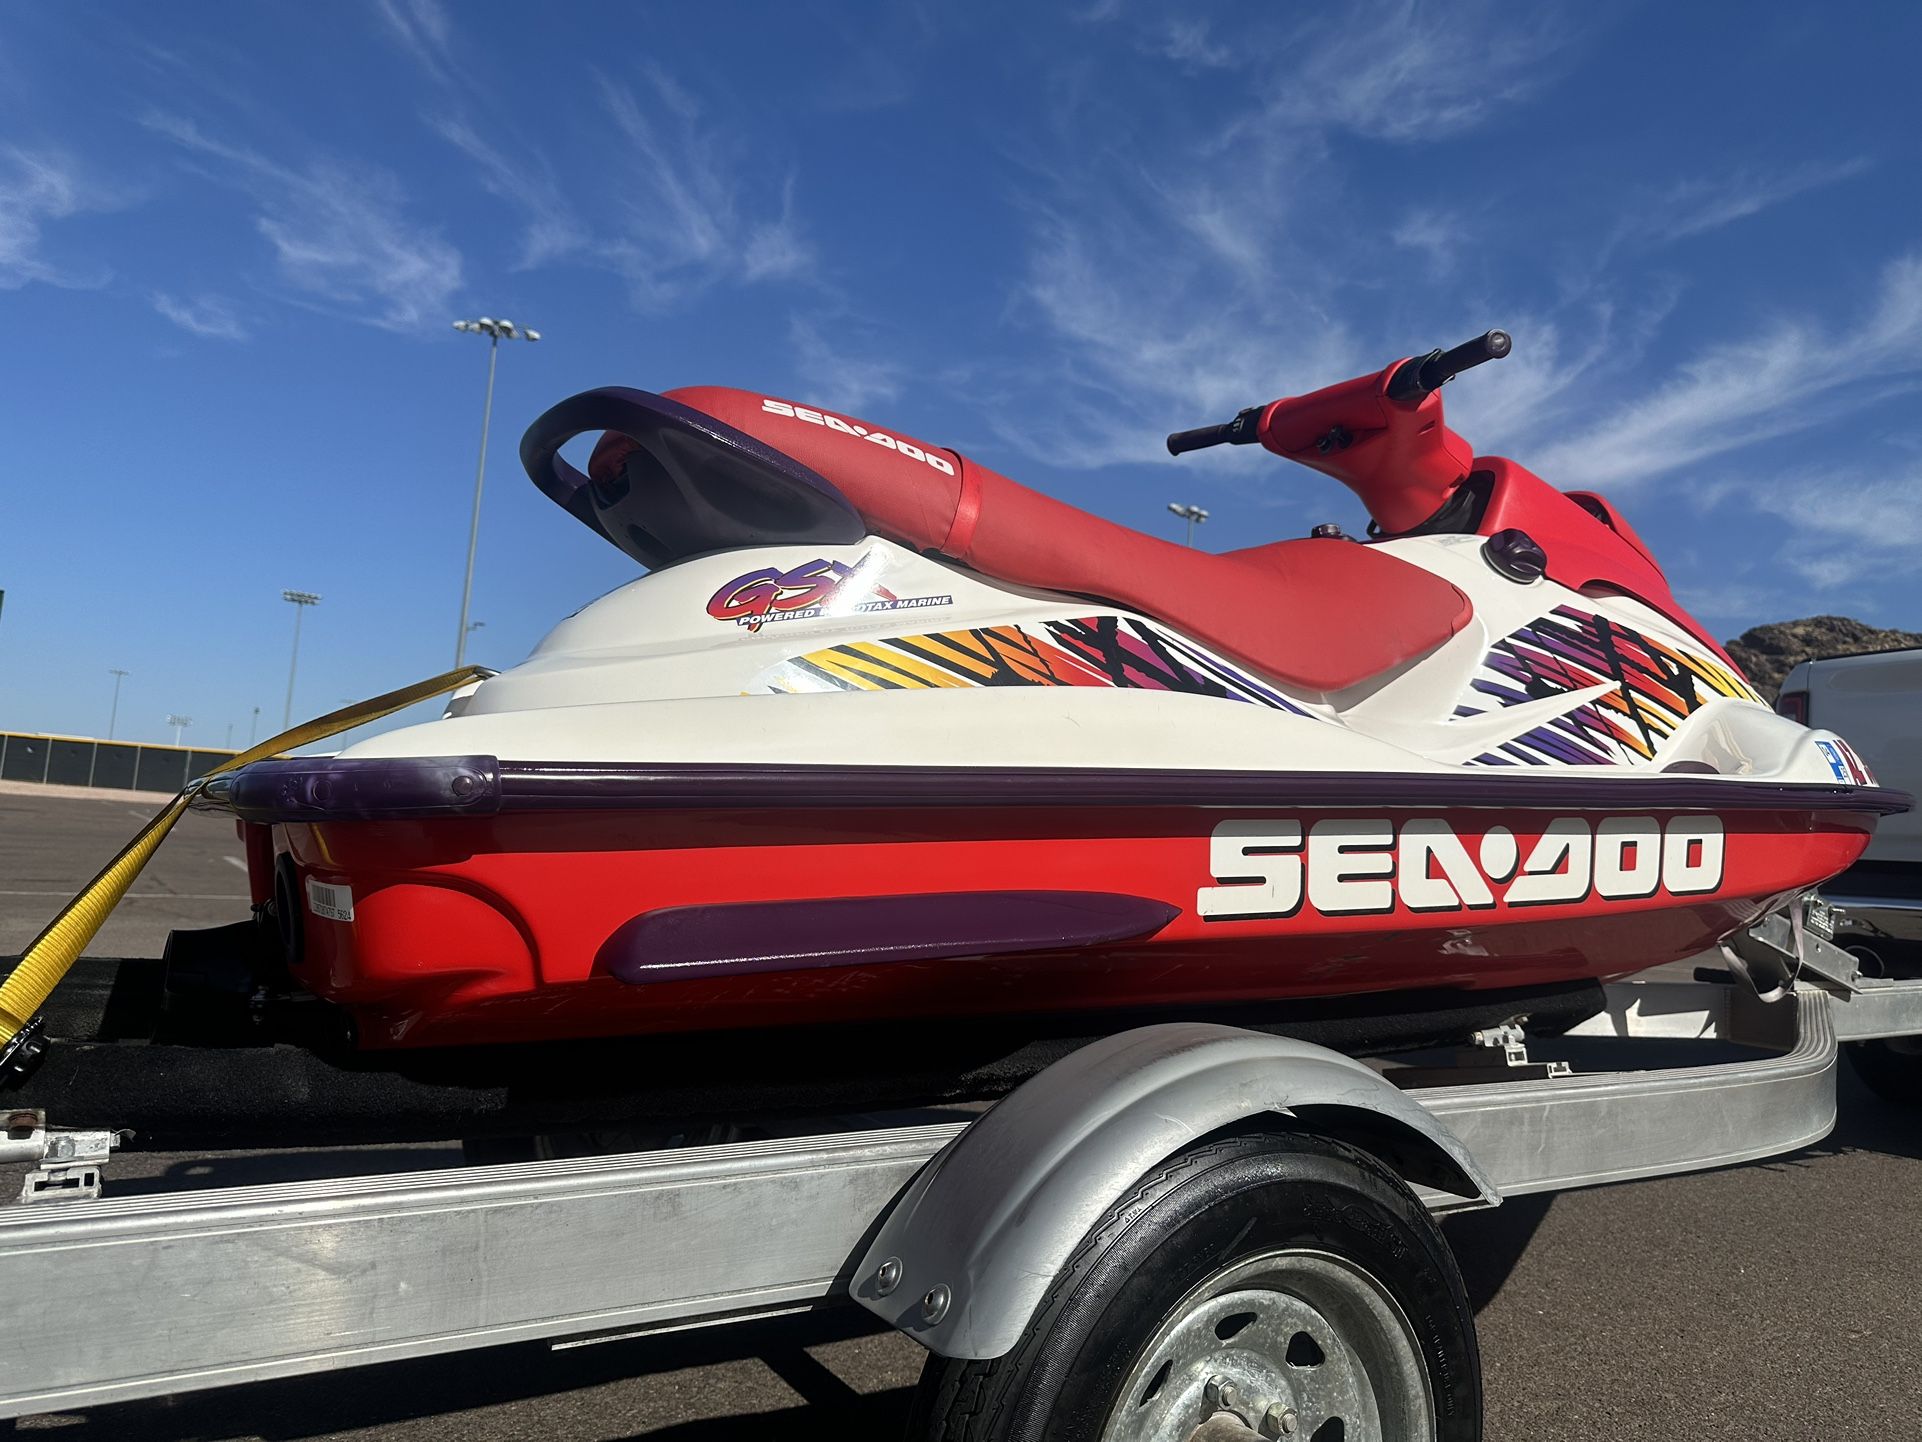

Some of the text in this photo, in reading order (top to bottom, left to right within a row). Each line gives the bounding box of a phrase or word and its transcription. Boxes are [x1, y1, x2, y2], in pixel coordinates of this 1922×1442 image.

[739, 610, 815, 625] POWERED
[847, 601, 893, 613] OTAX
[896, 597, 951, 609] MARINE
